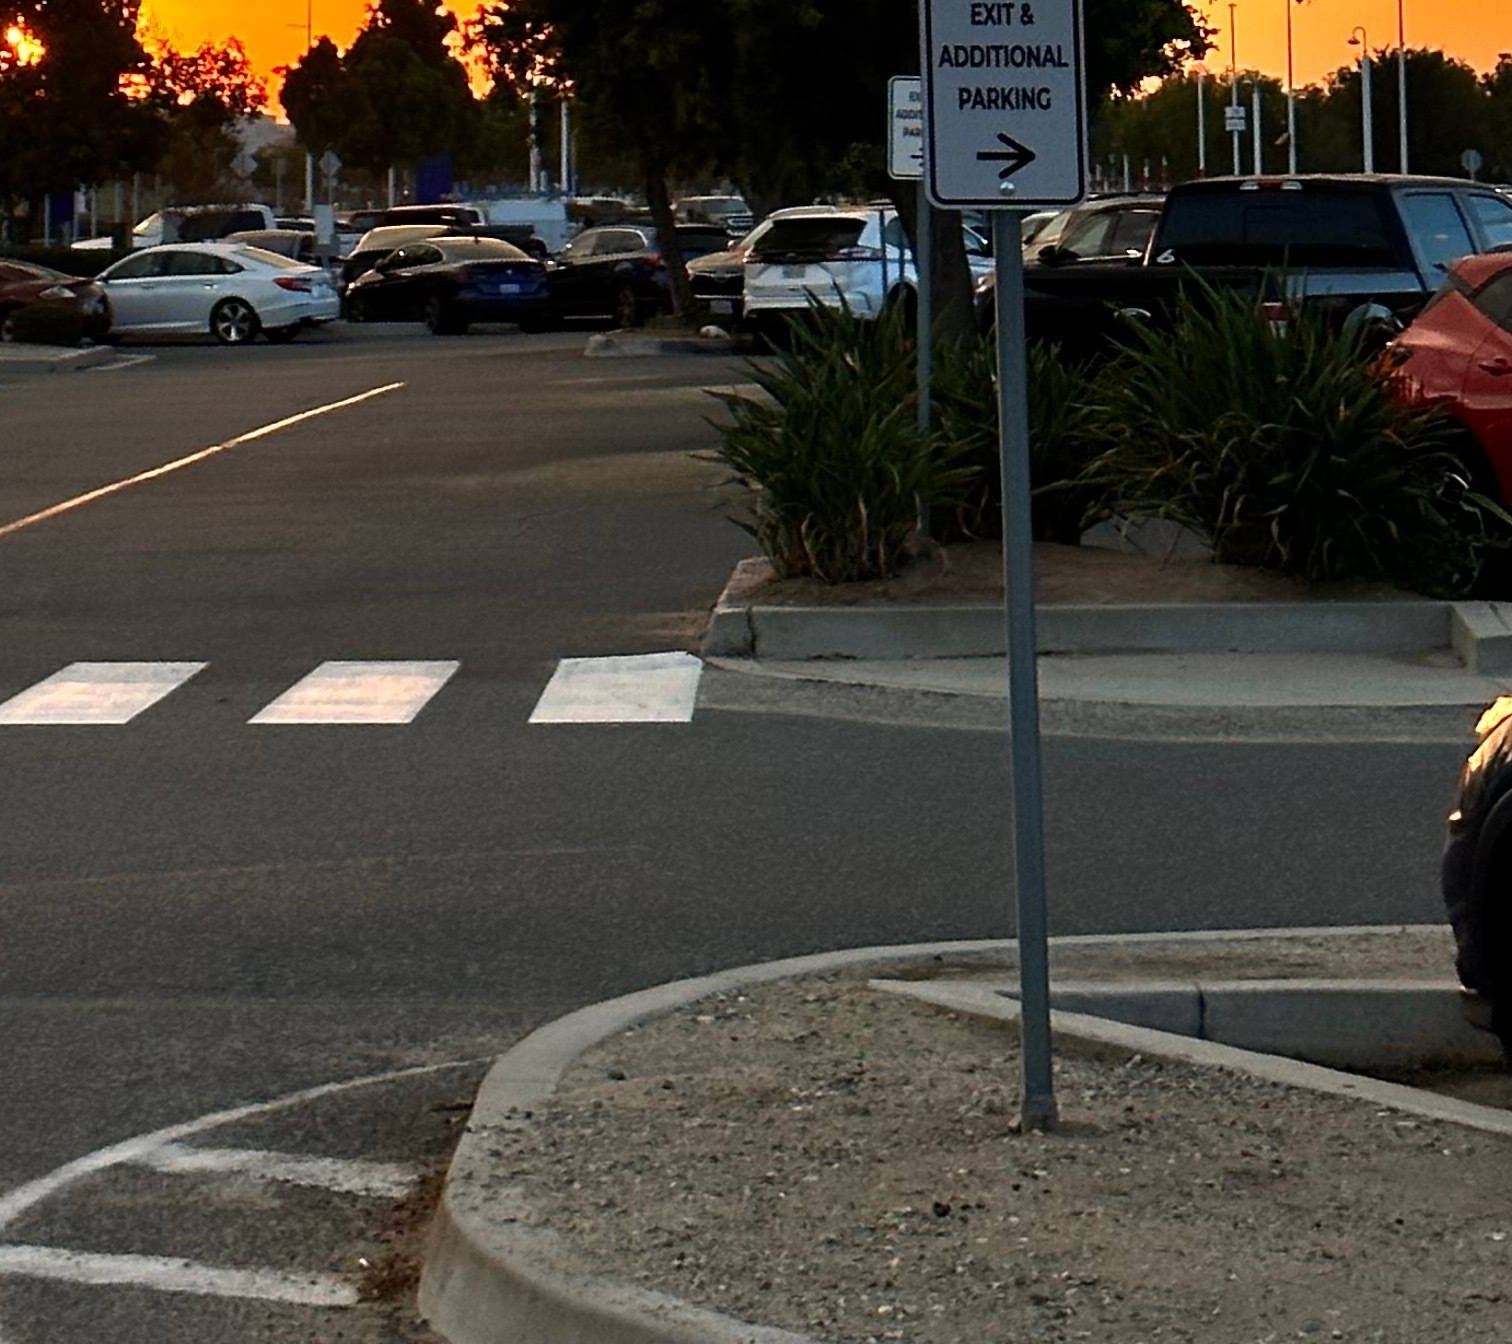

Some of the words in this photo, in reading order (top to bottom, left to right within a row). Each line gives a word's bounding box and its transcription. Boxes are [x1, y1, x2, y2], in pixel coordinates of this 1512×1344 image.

[970, 3, 1015, 26] EXIT
[1020, 2, 1034, 25] &
[939, 44, 1069, 68] ADDITIONAL
[958, 87, 1051, 110] PARKING
